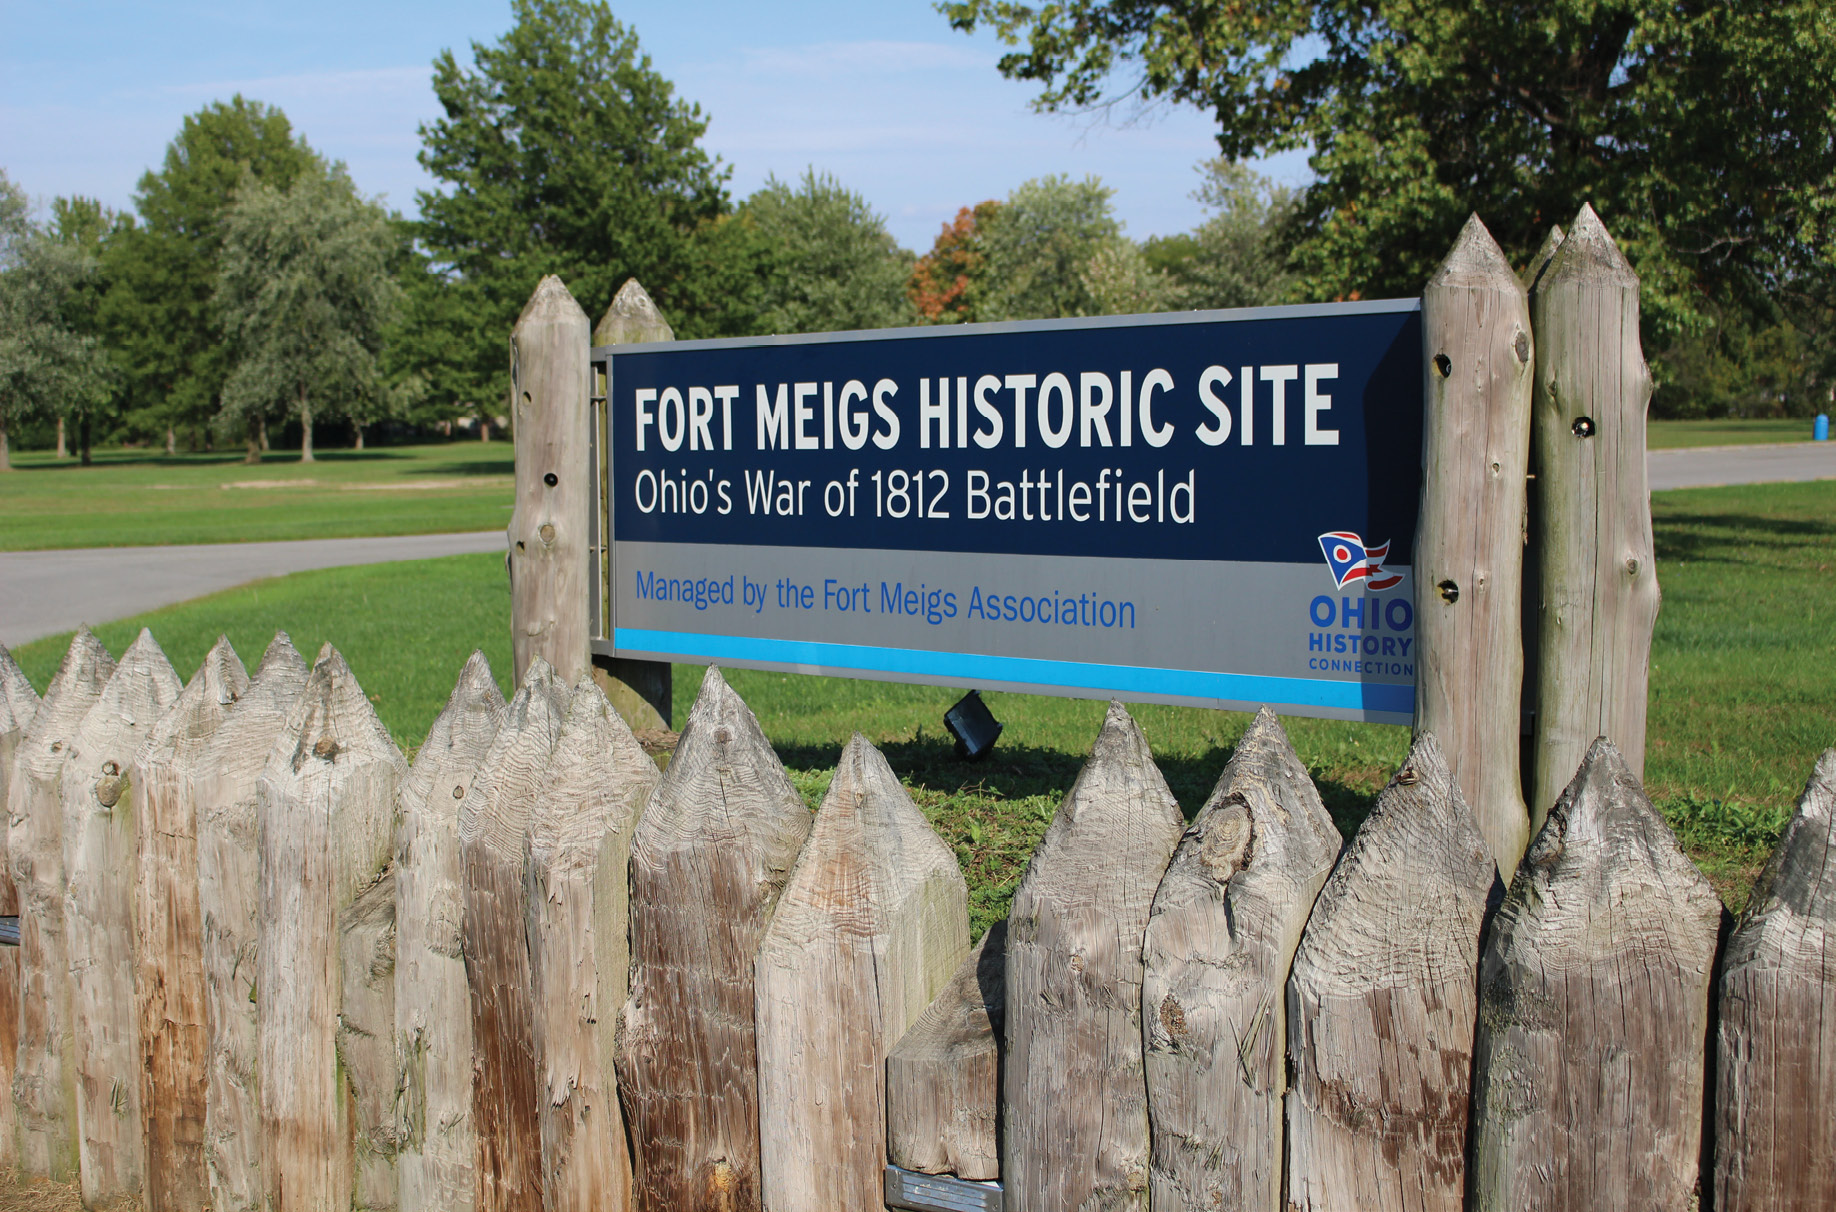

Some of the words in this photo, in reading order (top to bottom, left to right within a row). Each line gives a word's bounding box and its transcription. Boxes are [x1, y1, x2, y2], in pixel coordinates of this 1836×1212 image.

[635, 385, 739, 451] FORT
[756, 378, 900, 451] MEIGS
[919, 368, 1175, 449] HISTORIC
[1195, 363, 1340, 446] SITE
[635, 468, 732, 515] Ohio's
[744, 469, 811, 516] War
[824, 468, 859, 517] of
[871, 469, 950, 519] 1812
[967, 468, 1195, 524] Battlefield
[636, 570, 734, 611] Managed
[743, 576, 767, 613] by
[776, 578, 814, 610] the
[824, 579, 871, 613] Fort
[880, 581, 957, 625] Meigs
[968, 586, 1135, 629] Association
[1309, 595, 1413, 632] OHIO
[1309, 632, 1413, 657] HISTORY
[1309, 658, 1413, 676] CONNECTION
